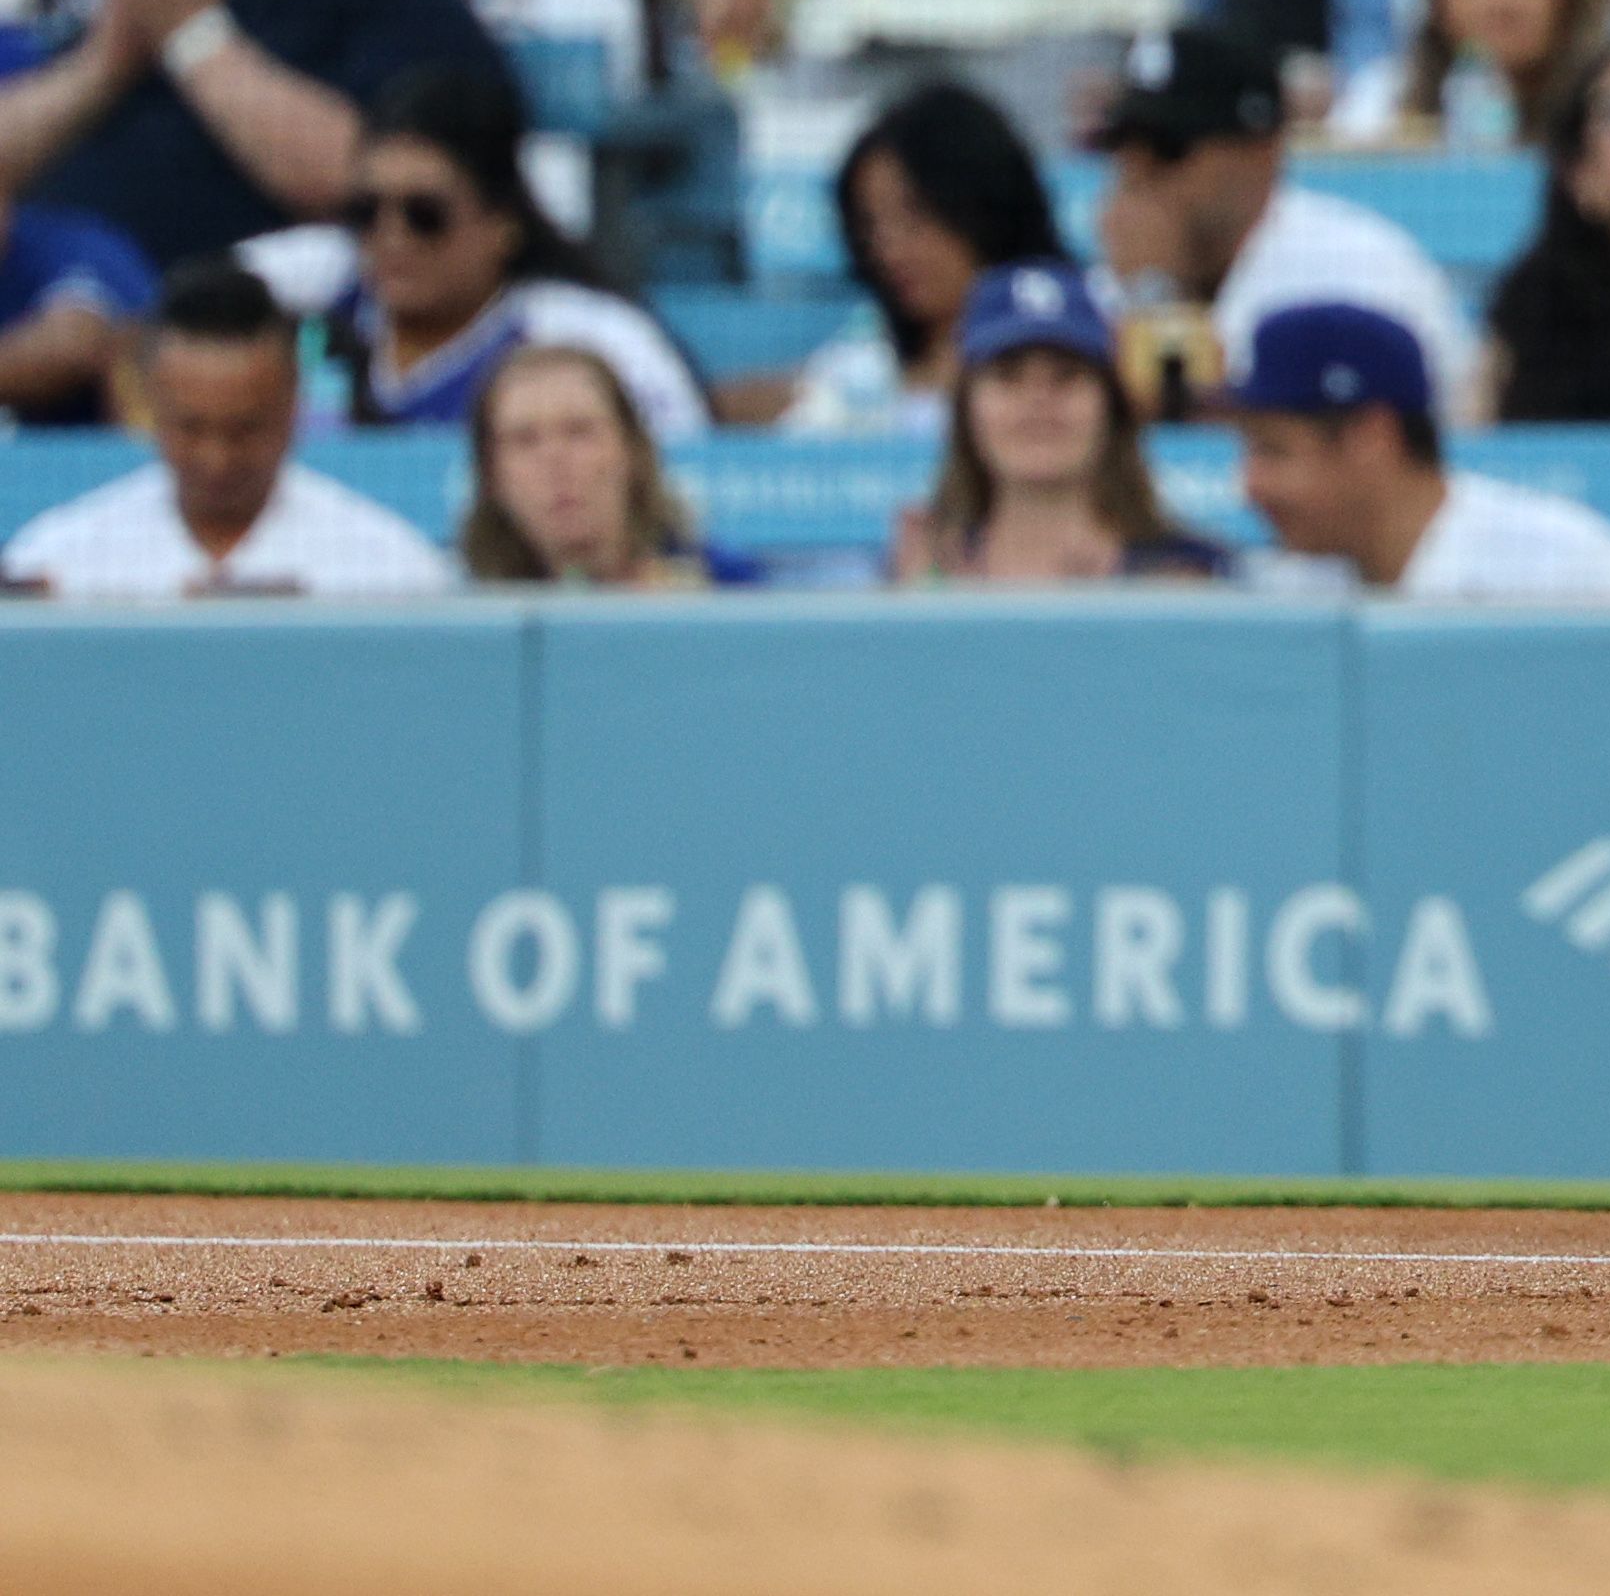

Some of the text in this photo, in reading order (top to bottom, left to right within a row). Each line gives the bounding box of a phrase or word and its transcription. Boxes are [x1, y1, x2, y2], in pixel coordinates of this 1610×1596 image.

[0, 881, 1494, 1040] BANK OF AMERICA
